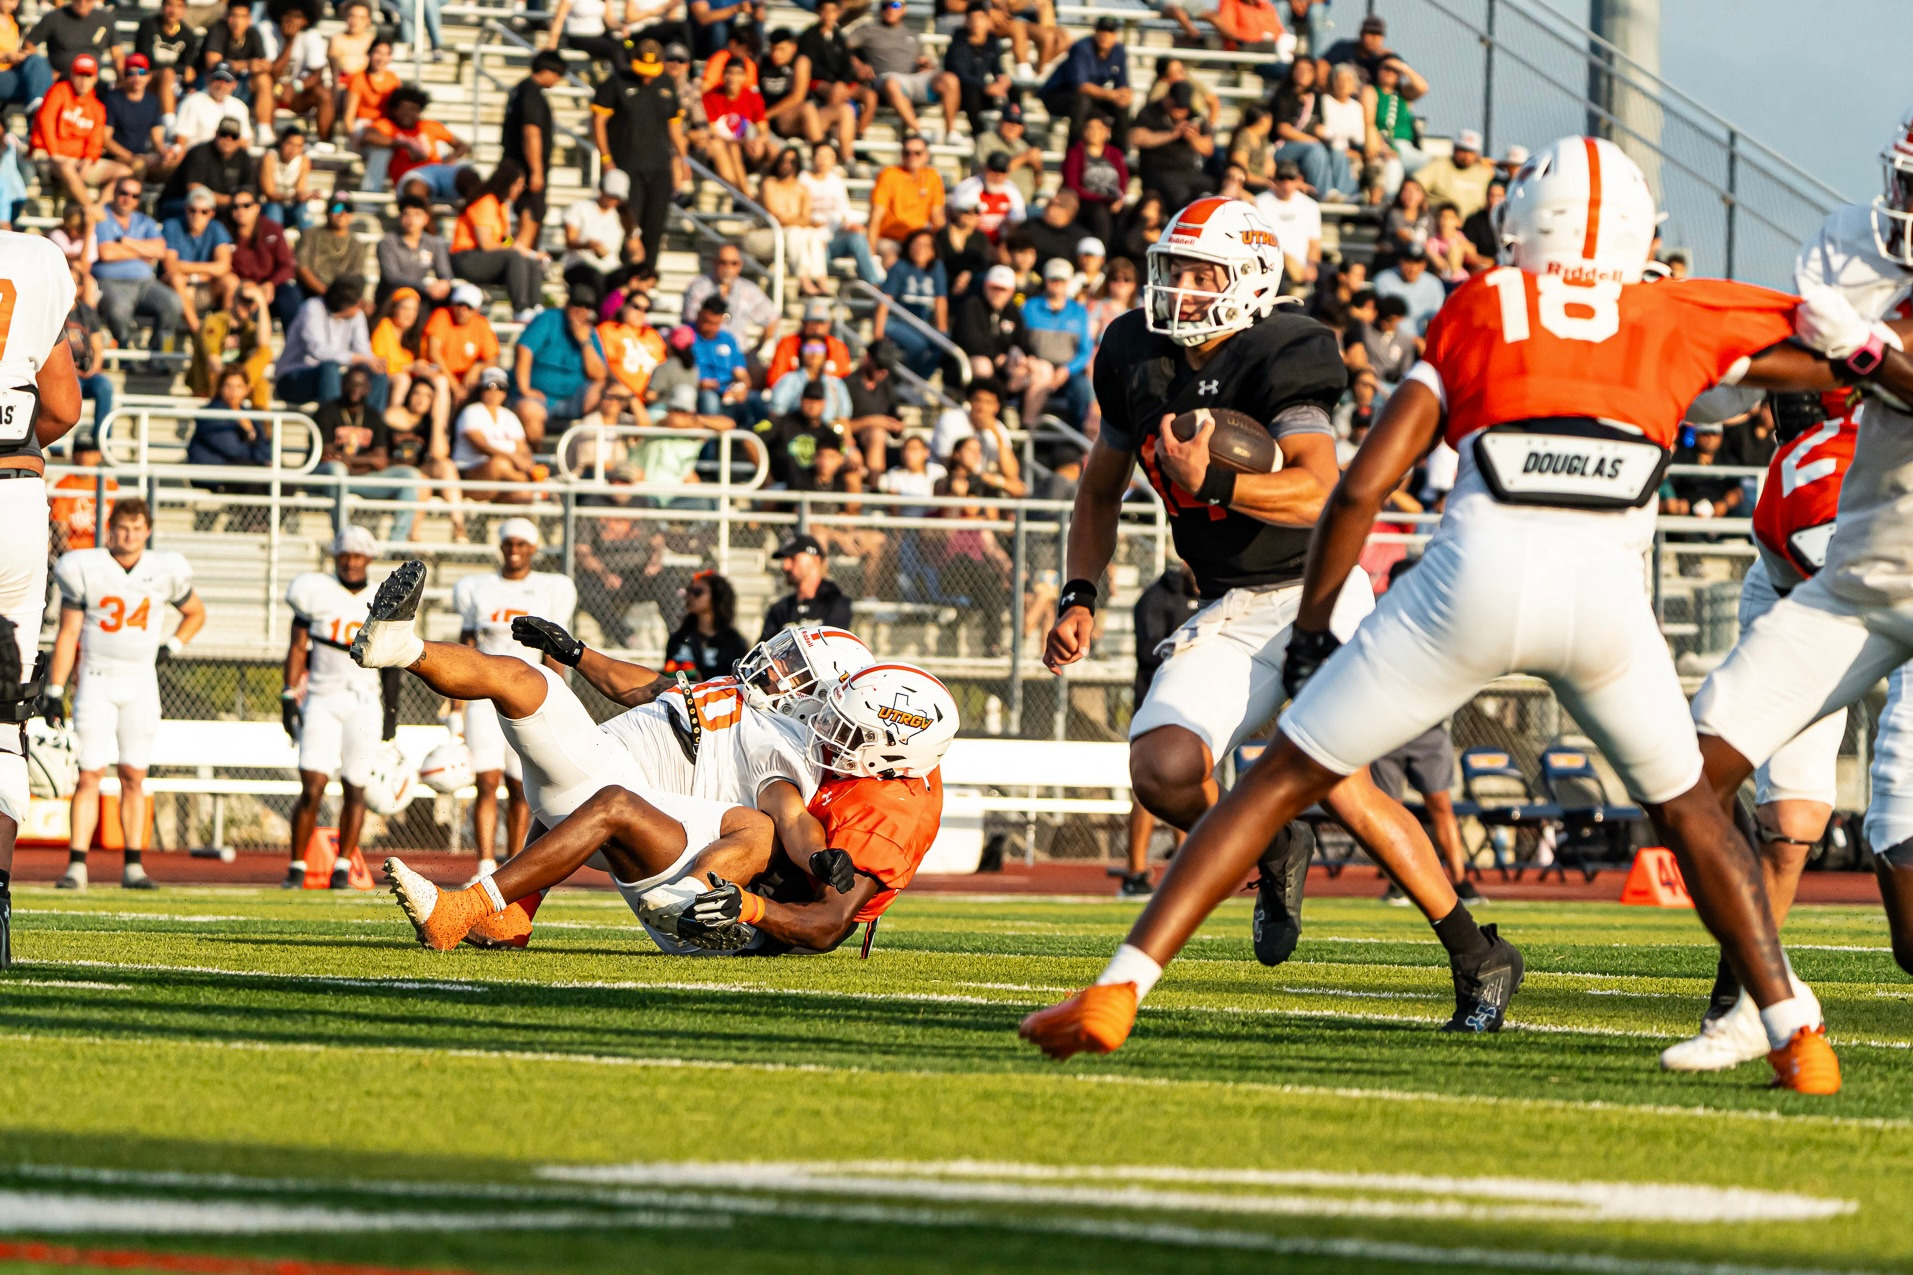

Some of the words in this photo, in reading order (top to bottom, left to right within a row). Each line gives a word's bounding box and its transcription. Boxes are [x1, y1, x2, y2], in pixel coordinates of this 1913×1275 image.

[1484, 266, 1623, 344] 18
[1523, 451, 1623, 479] DOUGLAS
[99, 596, 151, 633] 34
[877, 704, 935, 731] UTRGV
